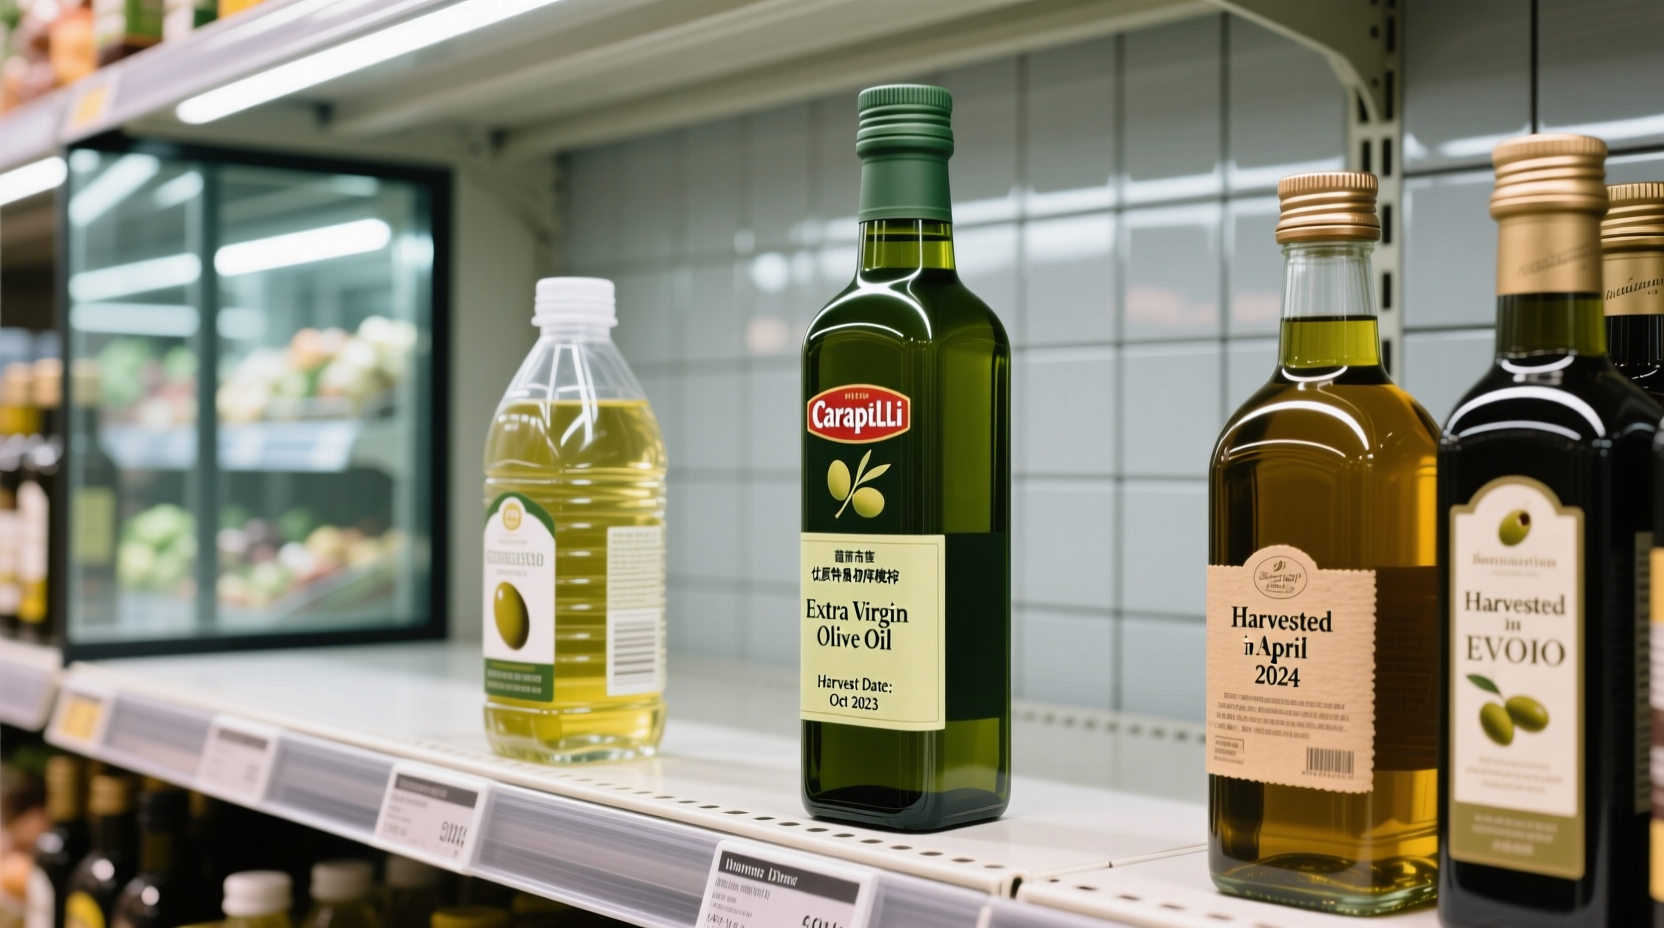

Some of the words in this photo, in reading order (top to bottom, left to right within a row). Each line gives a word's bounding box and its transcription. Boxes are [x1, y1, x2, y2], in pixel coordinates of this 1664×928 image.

[806, 599, 849, 621] Extra
[852, 601, 909, 629] Virgin
[1464, 591, 1566, 616] Harvested
[1231, 606, 1333, 633] Harvested
[1504, 618, 1521, 631] in
[817, 625, 860, 649] Olive
[864, 628, 892, 650] Oil
[1256, 635, 1308, 665] April
[817, 674, 860, 691] Harvest
[862, 677, 893, 694] Date:
[1254, 664, 1301, 688] 2024
[851, 695, 879, 711] 2023
